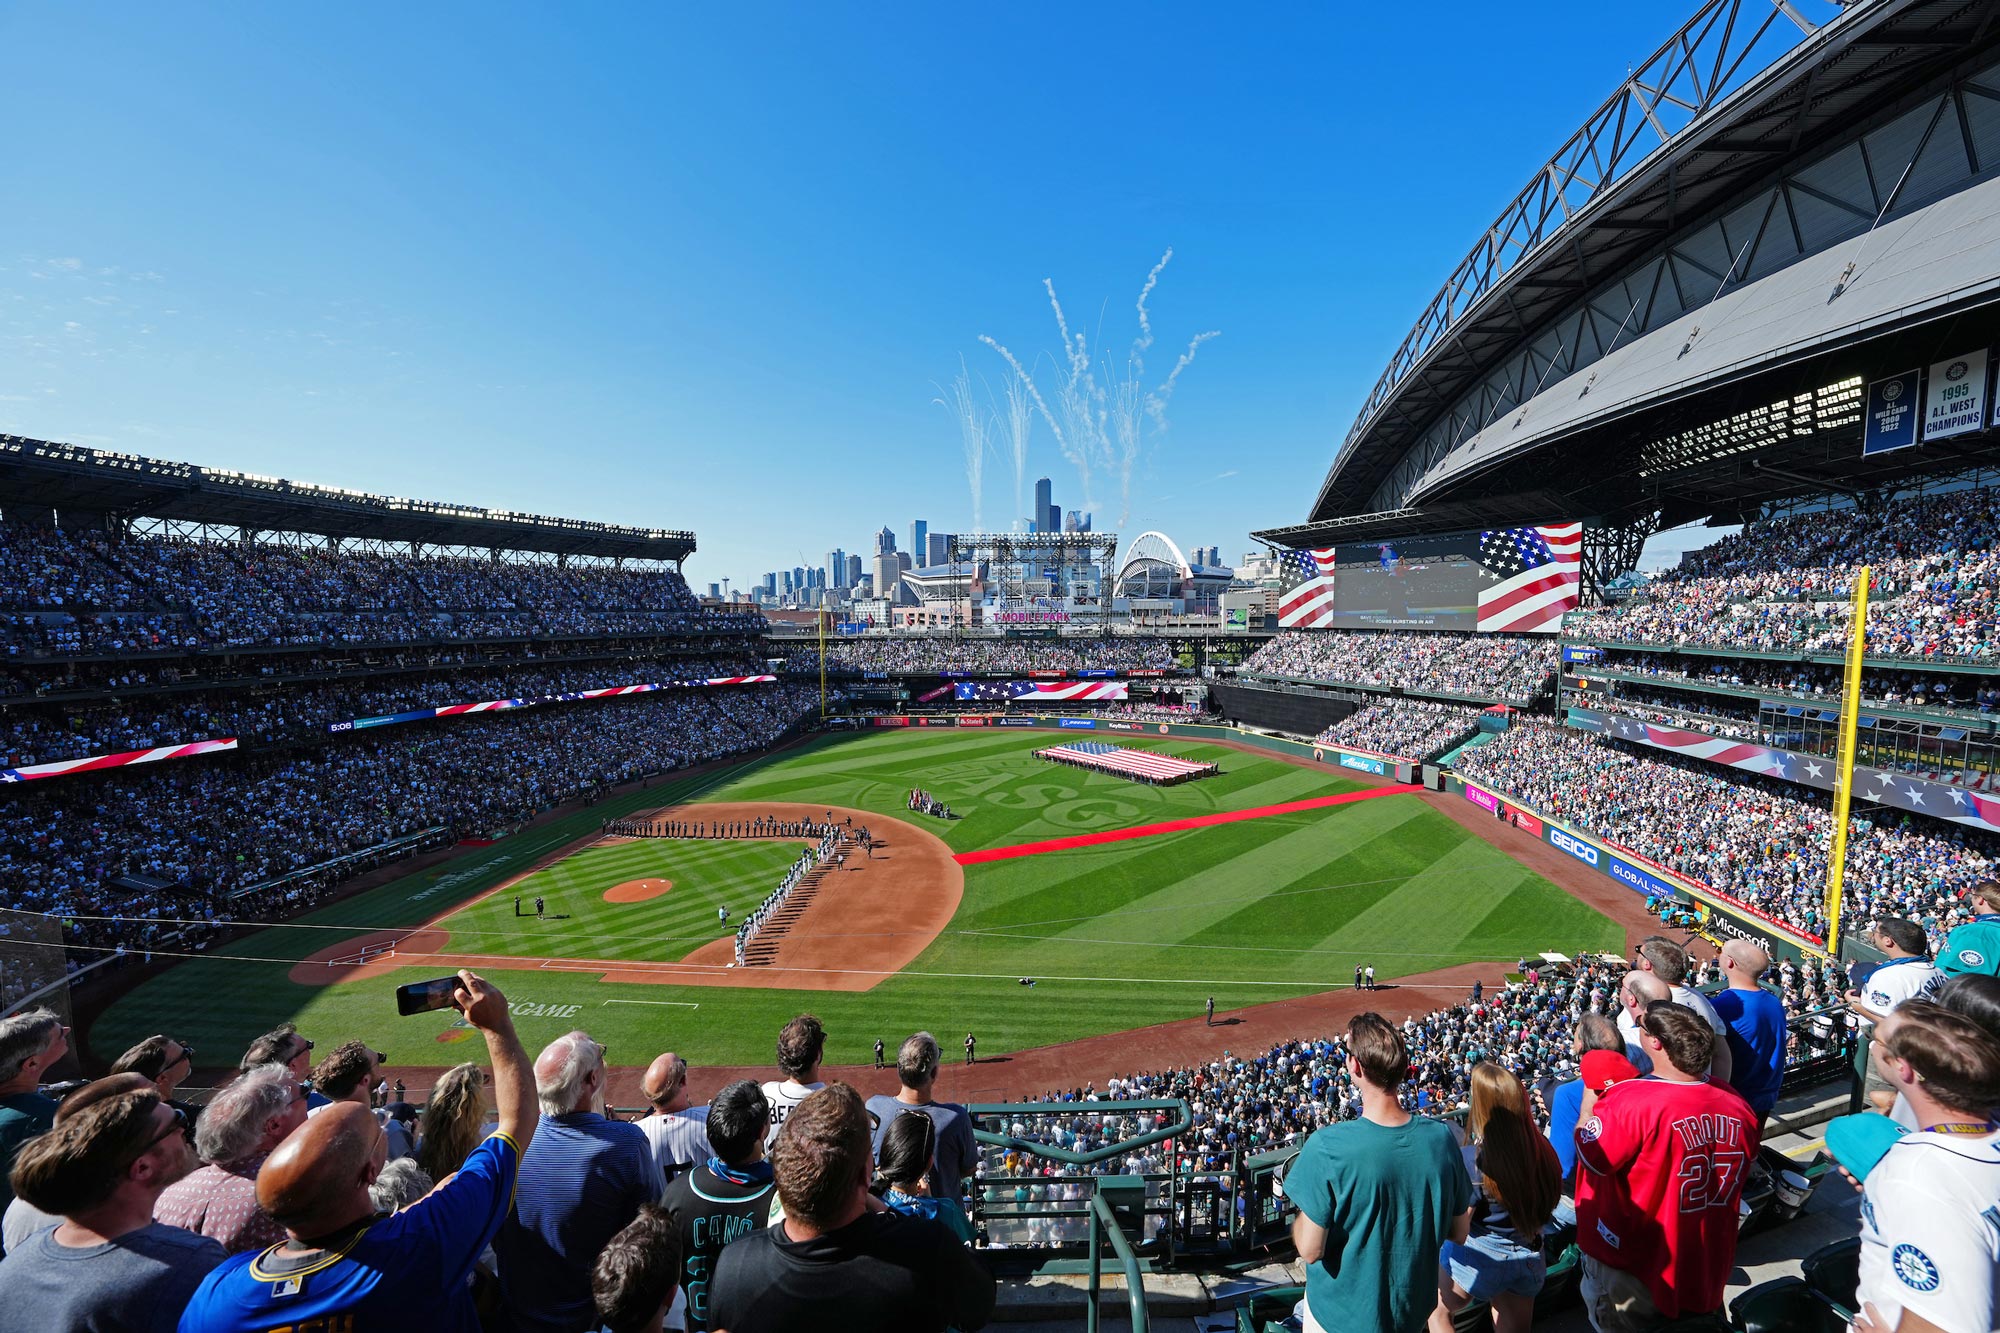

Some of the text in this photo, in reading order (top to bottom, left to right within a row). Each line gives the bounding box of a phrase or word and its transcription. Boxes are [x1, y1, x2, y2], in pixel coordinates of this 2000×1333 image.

[1941, 383, 1969, 401] 1995
[1875, 404, 1908, 420] WILD CARD
[1932, 398, 1976, 419] A.L. WEST
[1880, 422, 1900, 433] 2022
[1881, 414, 1900, 426] 2000
[1926, 411, 1980, 434] CHAMPIONS
[1043, 612, 1071, 623] PARK
[330, 722, 352, 732] 5:06
[1342, 757, 1369, 770] Alaska
[1476, 792, 1492, 808] Mobile
[1550, 829, 1598, 865] GEICO
[1613, 864, 1650, 891] GLOBAL
[1651, 883, 1669, 895] CREDIT
[1713, 913, 1770, 953] Microsoft
[511, 1001, 583, 1018] GAME
[1586, 1121, 1598, 1136] 50
[1671, 1113, 1742, 1151] TROUT
[1676, 1151, 1745, 1213] 27
[693, 1211, 755, 1249] CANÓ
